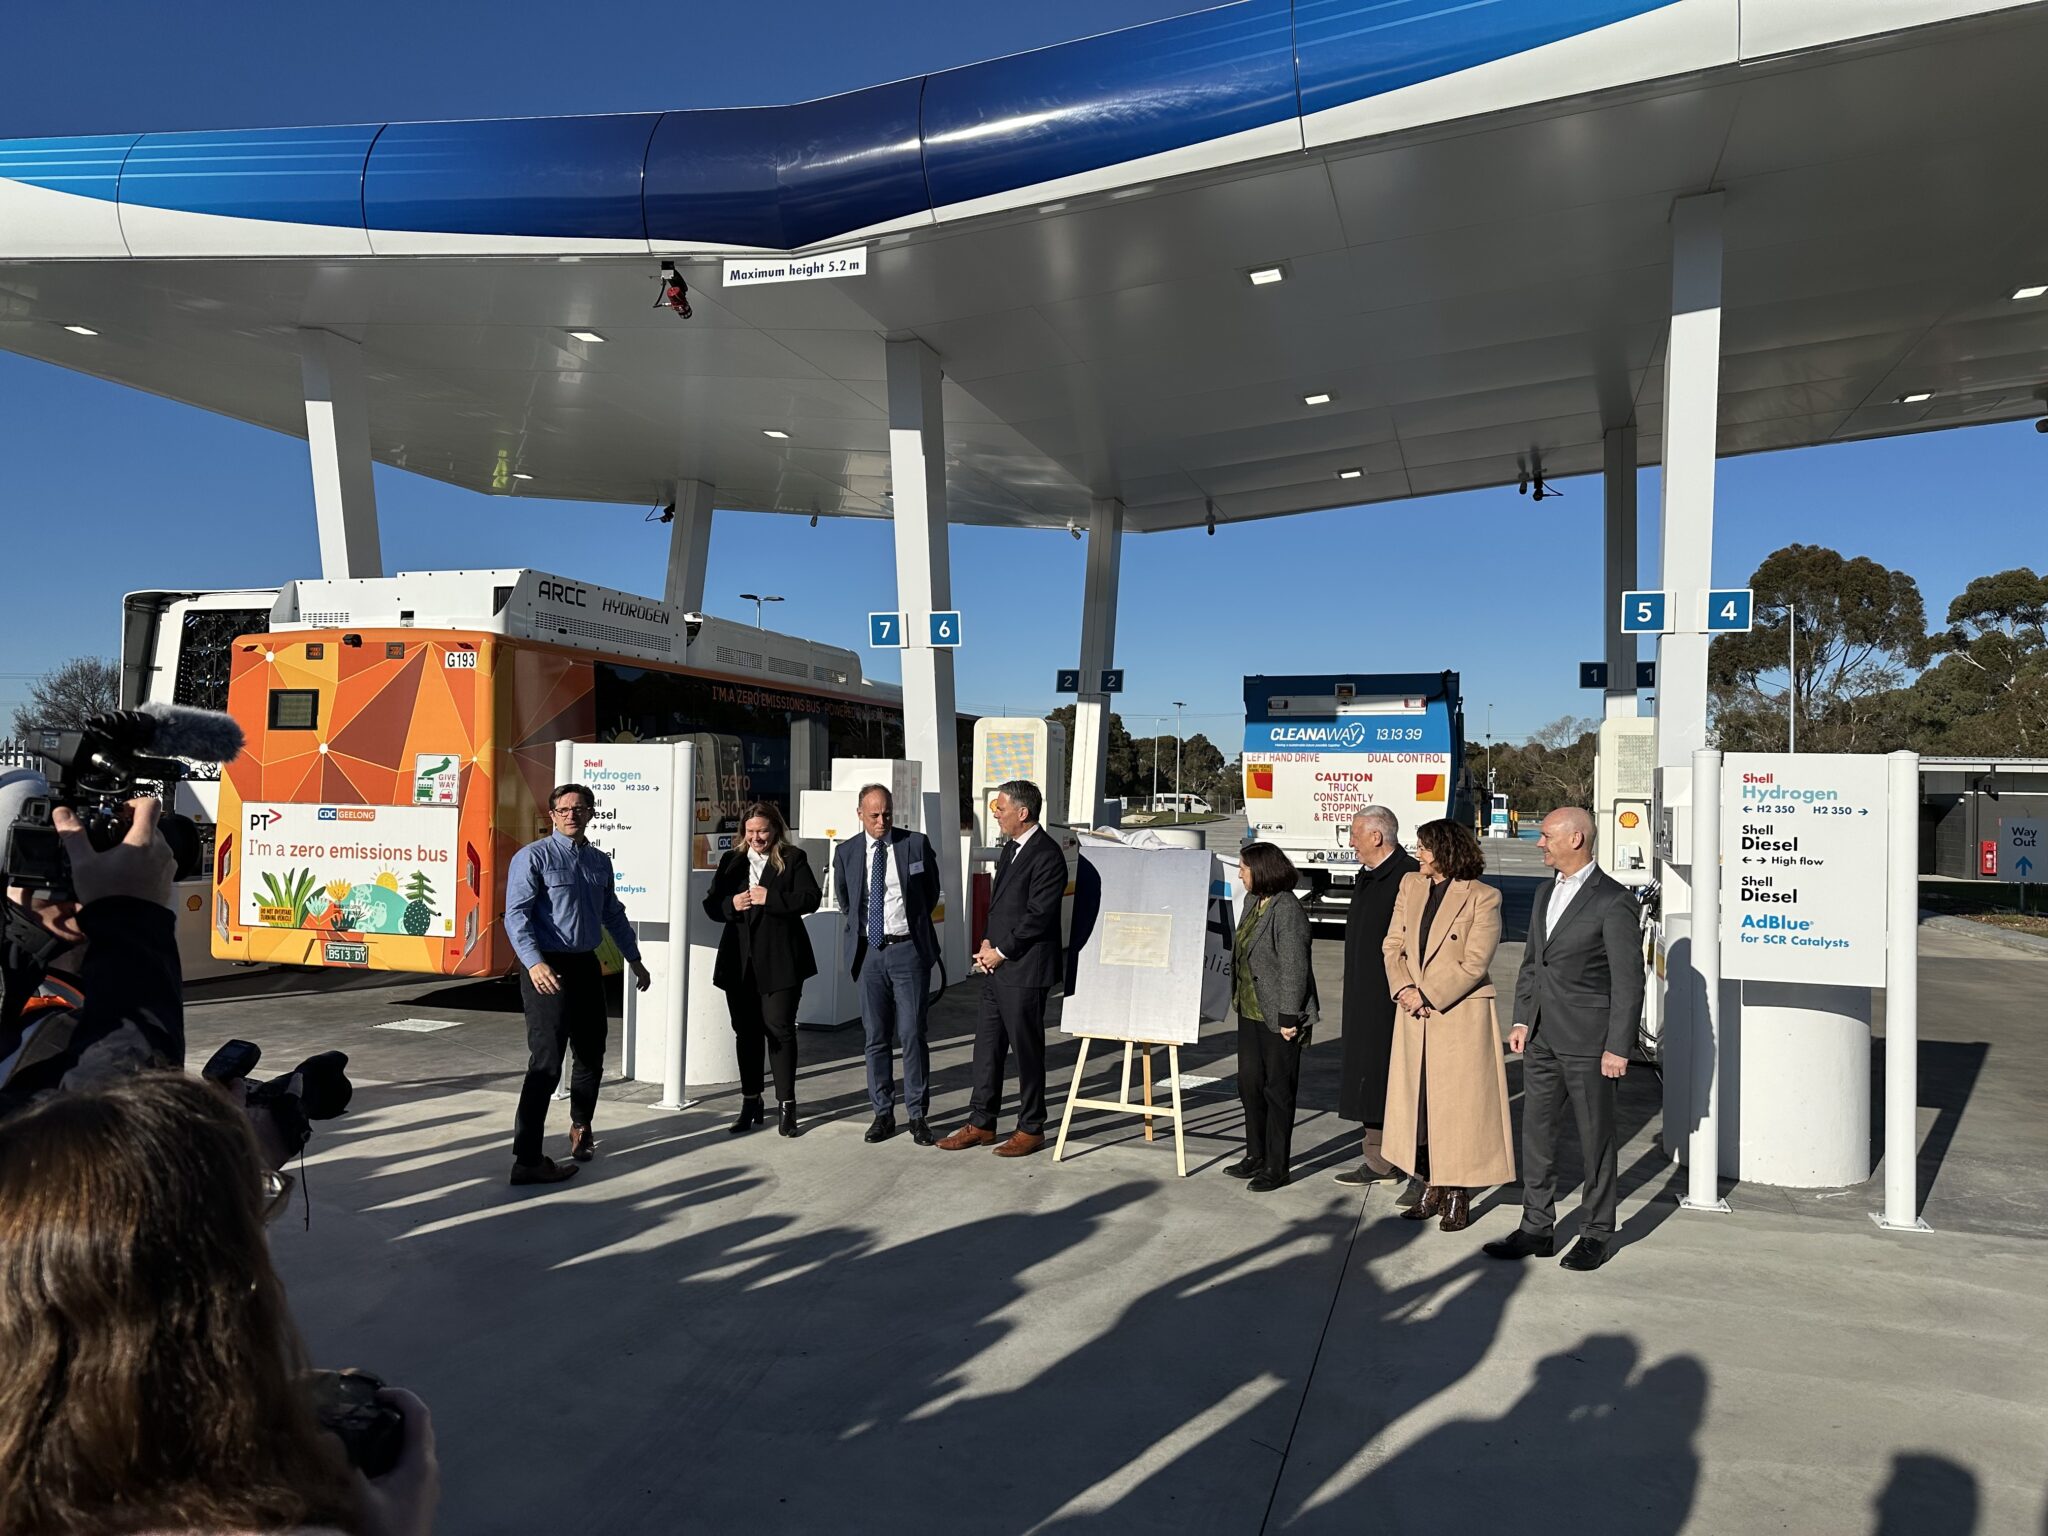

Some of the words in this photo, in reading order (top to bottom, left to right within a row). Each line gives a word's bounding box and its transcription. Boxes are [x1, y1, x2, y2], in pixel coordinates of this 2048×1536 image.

[730, 268, 785, 281] Maximum
[789, 262, 824, 277] height
[828, 259, 847, 272] 5.2
[849, 260, 860, 270] m
[538, 580, 587, 608] ARCC
[602, 597, 670, 626] HYDROGEN
[1637, 602, 1652, 622] 5
[1720, 600, 1737, 620] 4
[879, 621, 891, 638] 7
[939, 620, 951, 638] 6
[447, 653, 475, 667] G193
[1064, 675, 1073, 687] 2
[1107, 675, 1116, 687] 2
[1590, 668, 1598, 682] 1
[1645, 668, 1653, 682] 1
[737, 689, 759, 706] ZERO
[761, 693, 805, 712] EMISSIONS
[1270, 727, 1361, 741] CLEANAWAY
[1405, 728, 1423, 740] 39
[584, 760, 603, 768] Shell
[1247, 754, 1266, 762] LEFT
[1269, 753, 1292, 763] HAND
[1295, 753, 1320, 763] DRIVE
[1367, 753, 1394, 763] DUAL
[1397, 753, 1446, 763] CONTROL
[583, 769, 641, 783] Hydrogen
[1315, 772, 1373, 782] CAUTION
[1743, 773, 1773, 783] Shell
[722, 775, 751, 792] zero
[1328, 783, 1359, 792] TRUCK
[1313, 793, 1374, 803] CONSTANTLY
[1743, 785, 1838, 803] Hydrogen
[319, 809, 336, 820] CDC
[338, 811, 375, 821] GEELONG
[1757, 805, 1771, 813] H2
[1775, 805, 1795, 814] 350
[1813, 806, 1828, 814] H2
[1831, 806, 1852, 815] 350
[250, 815, 269, 831] PT
[1314, 813, 1320, 822] &
[1322, 813, 1353, 822] REVER
[617, 823, 632, 831] flow
[1742, 824, 1773, 835] Shell
[2012, 827, 2037, 838] Way
[1742, 836, 1798, 851] Diesel
[2013, 838, 2036, 847] Out
[249, 839, 272, 856] I'm
[276, 844, 285, 856] a
[290, 843, 325, 858] zero
[329, 842, 412, 861] emissions
[417, 844, 448, 862] bus
[1772, 856, 1797, 866] High
[1800, 856, 1824, 865] flow
[1741, 876, 1773, 887] Shell
[616, 885, 646, 894] atalysts
[1741, 887, 1797, 903] Diesel
[1741, 933, 1759, 943] for
[1763, 935, 1787, 945] SCR
[1791, 936, 1850, 949] Catalysts
[354, 951, 366, 961] DY
